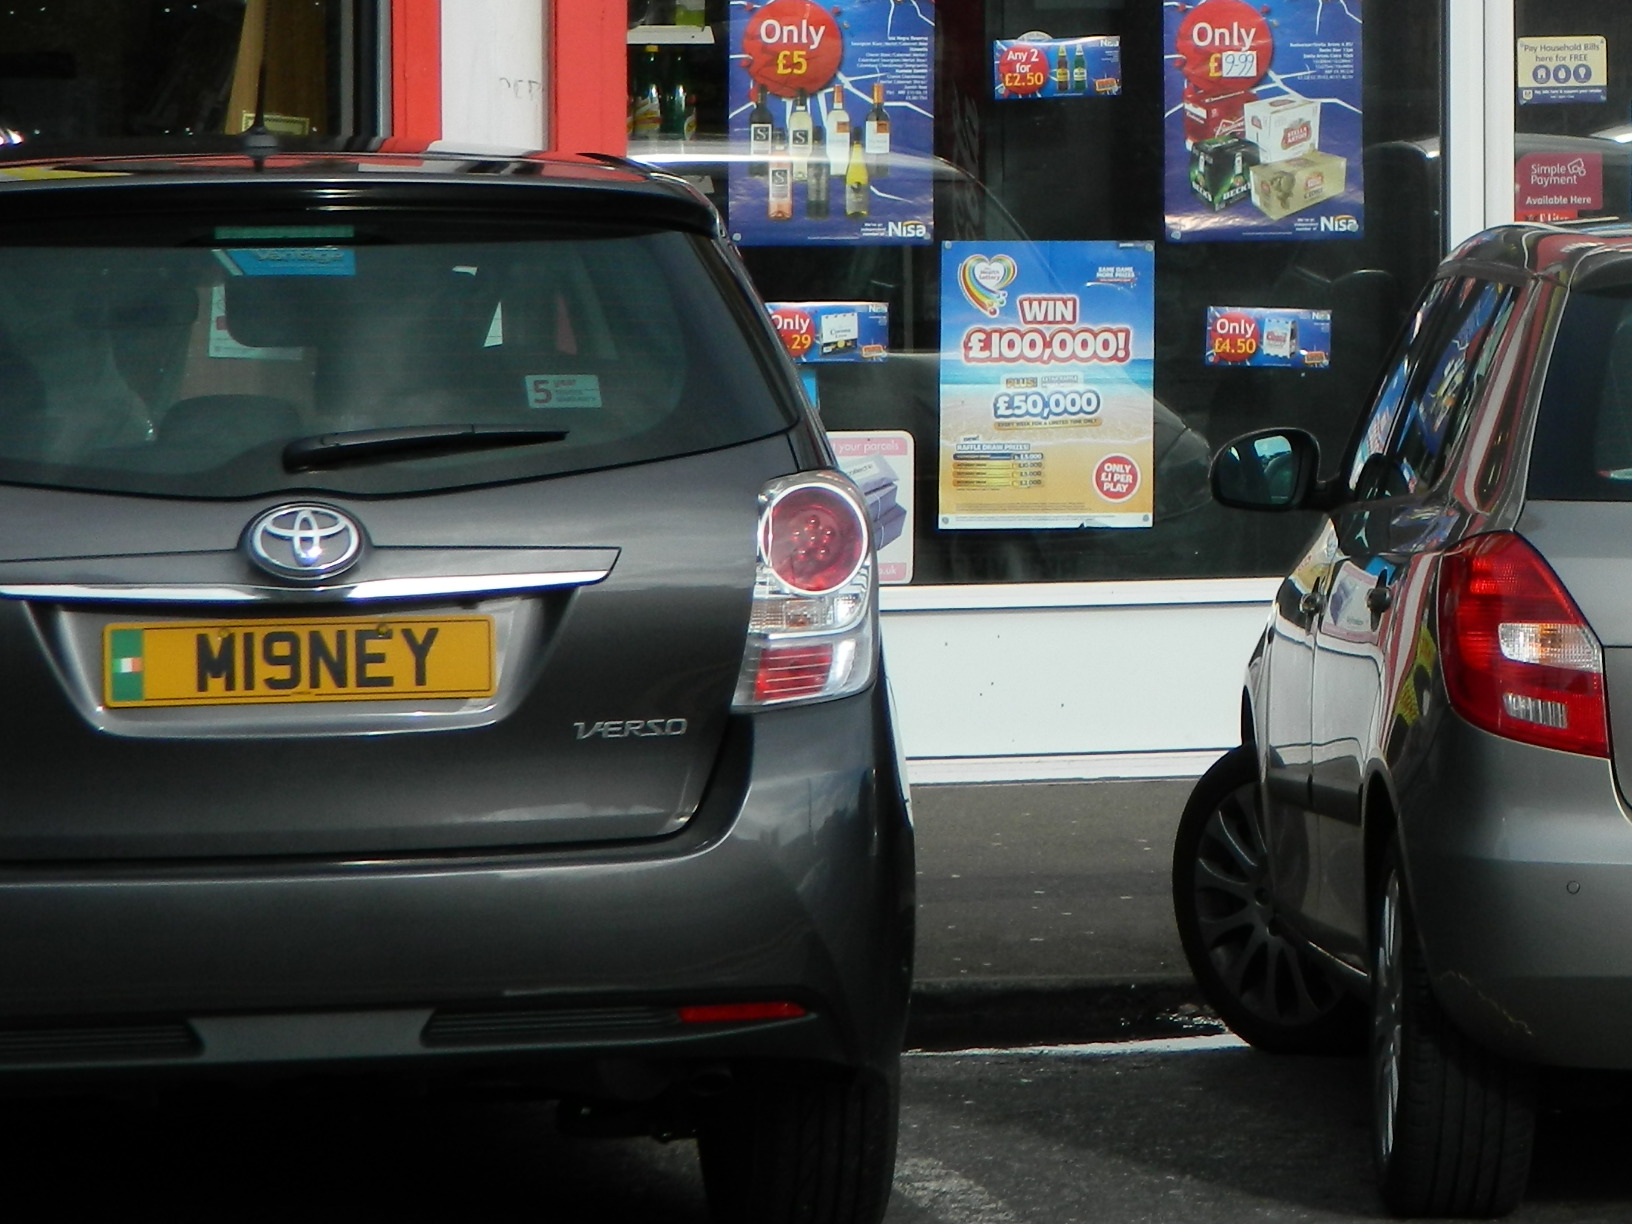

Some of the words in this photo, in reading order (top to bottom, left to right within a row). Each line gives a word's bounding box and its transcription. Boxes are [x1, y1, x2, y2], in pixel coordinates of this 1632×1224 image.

[760, 19, 825, 50] Only
[1192, 21, 1256, 53] Only
[1524, 44, 1538, 53] Pay
[1540, 43, 1582, 52] Household
[1583, 42, 1600, 51] Bills
[776, 50, 808, 75] £5
[1007, 50, 1028, 62] Any
[1030, 49, 1039, 62] 2
[1555, 54, 1567, 62] for
[1569, 53, 1588, 62] FREE
[1015, 63, 1032, 73] for
[1004, 72, 1044, 86] £2.50
[1531, 163, 1567, 176] Simple
[1530, 175, 1578, 188] Payment
[1525, 196, 1568, 205] Available
[1570, 195, 1592, 204] Here
[887, 220, 927, 237] Nisa
[1320, 216, 1358, 232] Nisa
[1022, 300, 1074, 322] WIN
[1216, 318, 1256, 338] Only
[968, 331, 1127, 361] £100,000!
[1214, 337, 1257, 354] £4.50
[532, 379, 553, 404] 5
[996, 392, 1098, 418] £50,000
[838, 443, 861, 455] your
[863, 440, 900, 454] parcels
[1104, 462, 1132, 472] ONLY
[1113, 473, 1133, 484] PER
[1103, 483, 1129, 493] PLAY
[573, 717, 688, 740] VERSO
